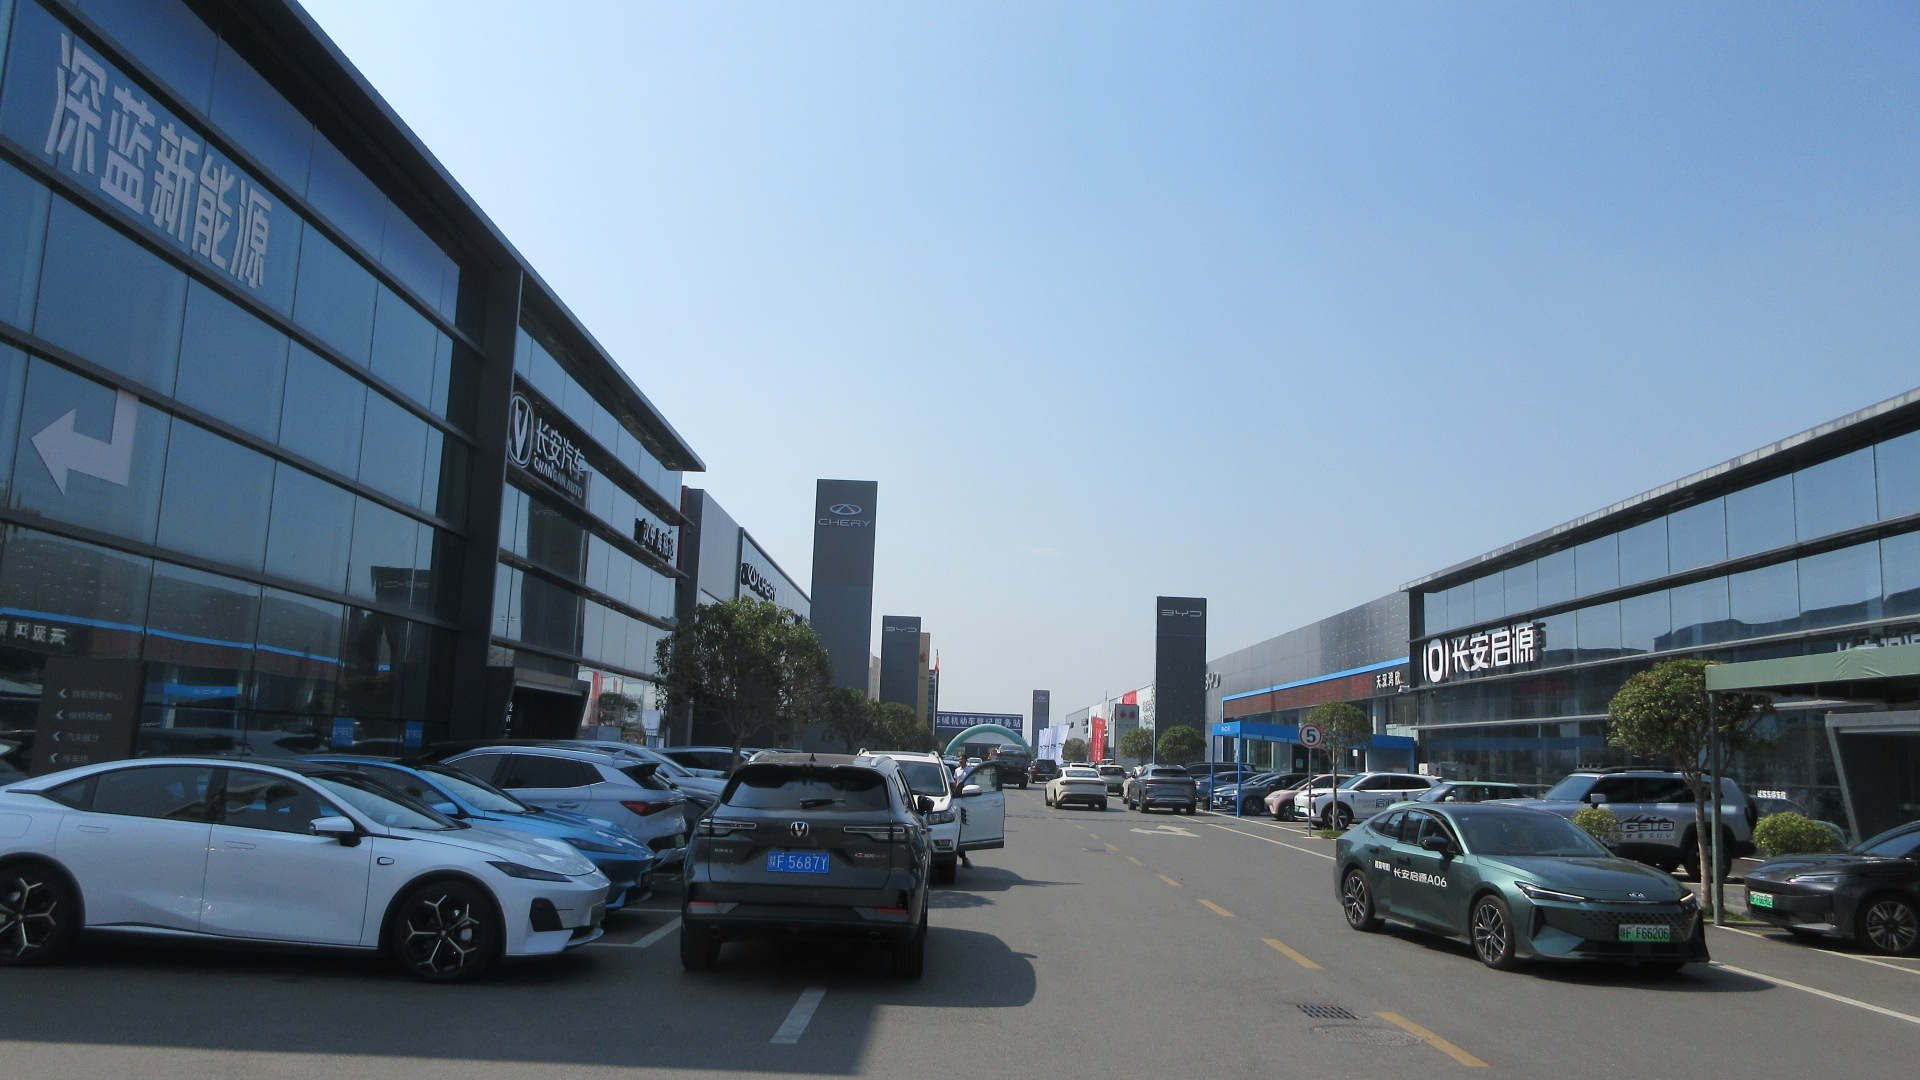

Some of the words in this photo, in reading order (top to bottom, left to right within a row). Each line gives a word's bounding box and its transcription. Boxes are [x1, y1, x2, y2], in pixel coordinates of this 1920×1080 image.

[45, 32, 272, 289] 深蓝新能源
[536, 417, 586, 481] 长安汽车
[566, 479, 583, 499] AUTO
[817, 518, 872, 527] CHERY
[1161, 609, 1202, 617] BYD
[1451, 621, 1535, 673] 长安启源
[1306, 728, 1316, 744] 5
[789, 855, 828, 870] 5687Y
[1393, 867, 1447, 888] 长安启源A06
